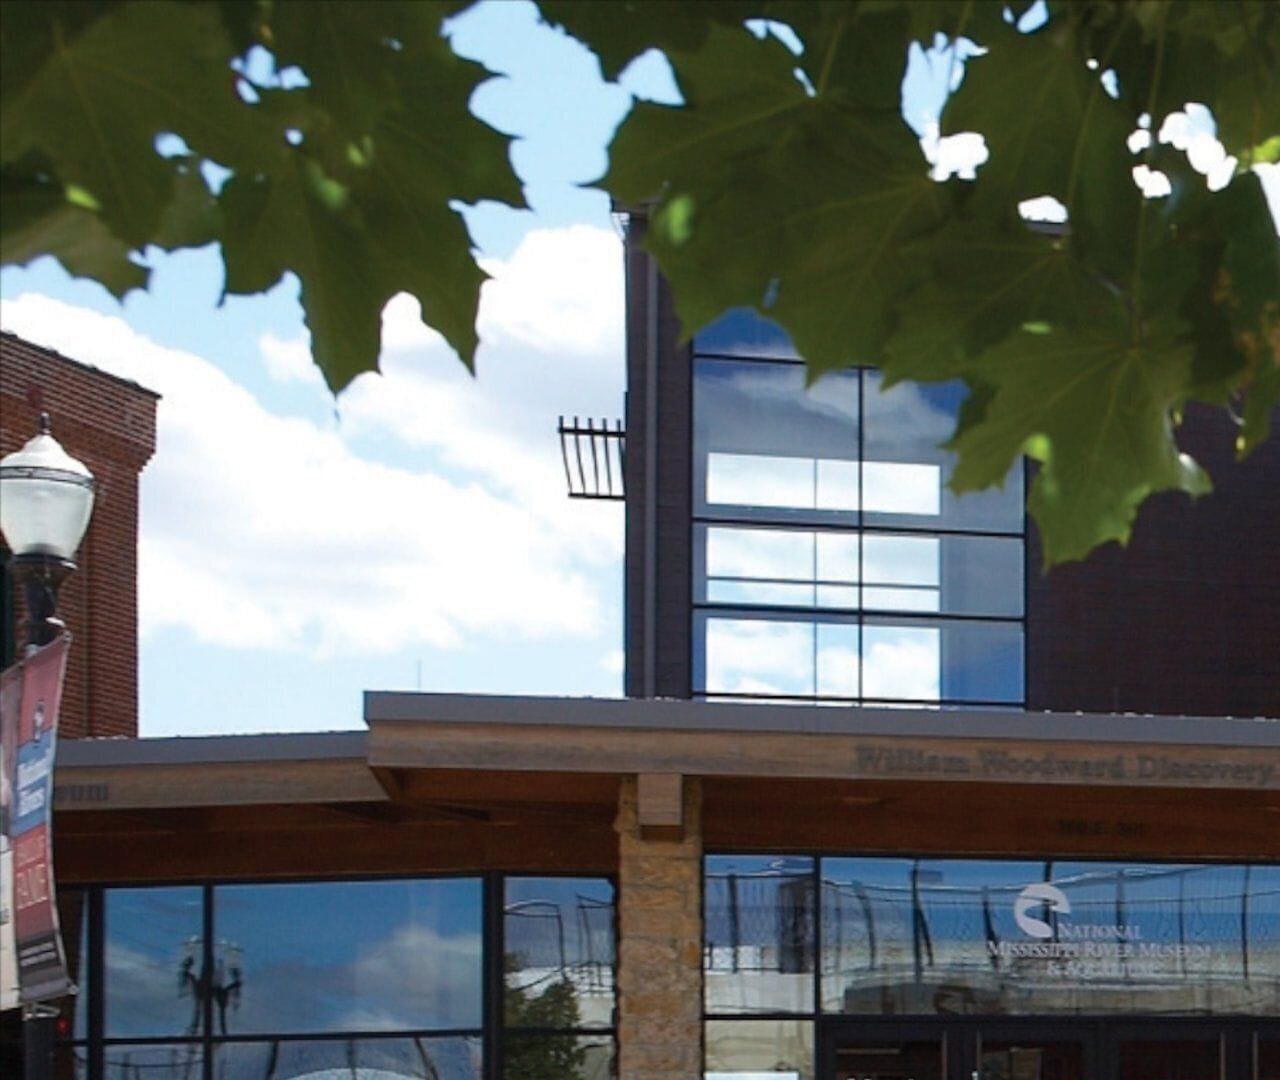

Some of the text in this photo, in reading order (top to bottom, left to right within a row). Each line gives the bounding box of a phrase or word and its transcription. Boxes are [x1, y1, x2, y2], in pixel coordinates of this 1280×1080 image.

[855, 745, 969, 773] William
[979, 749, 1124, 778] Woodward
[1137, 756, 1275, 787] Discovery
[1058, 923, 1143, 938] NATIONAL
[986, 941, 1212, 958] MISSISSIPPI RIVER MUSEUM
